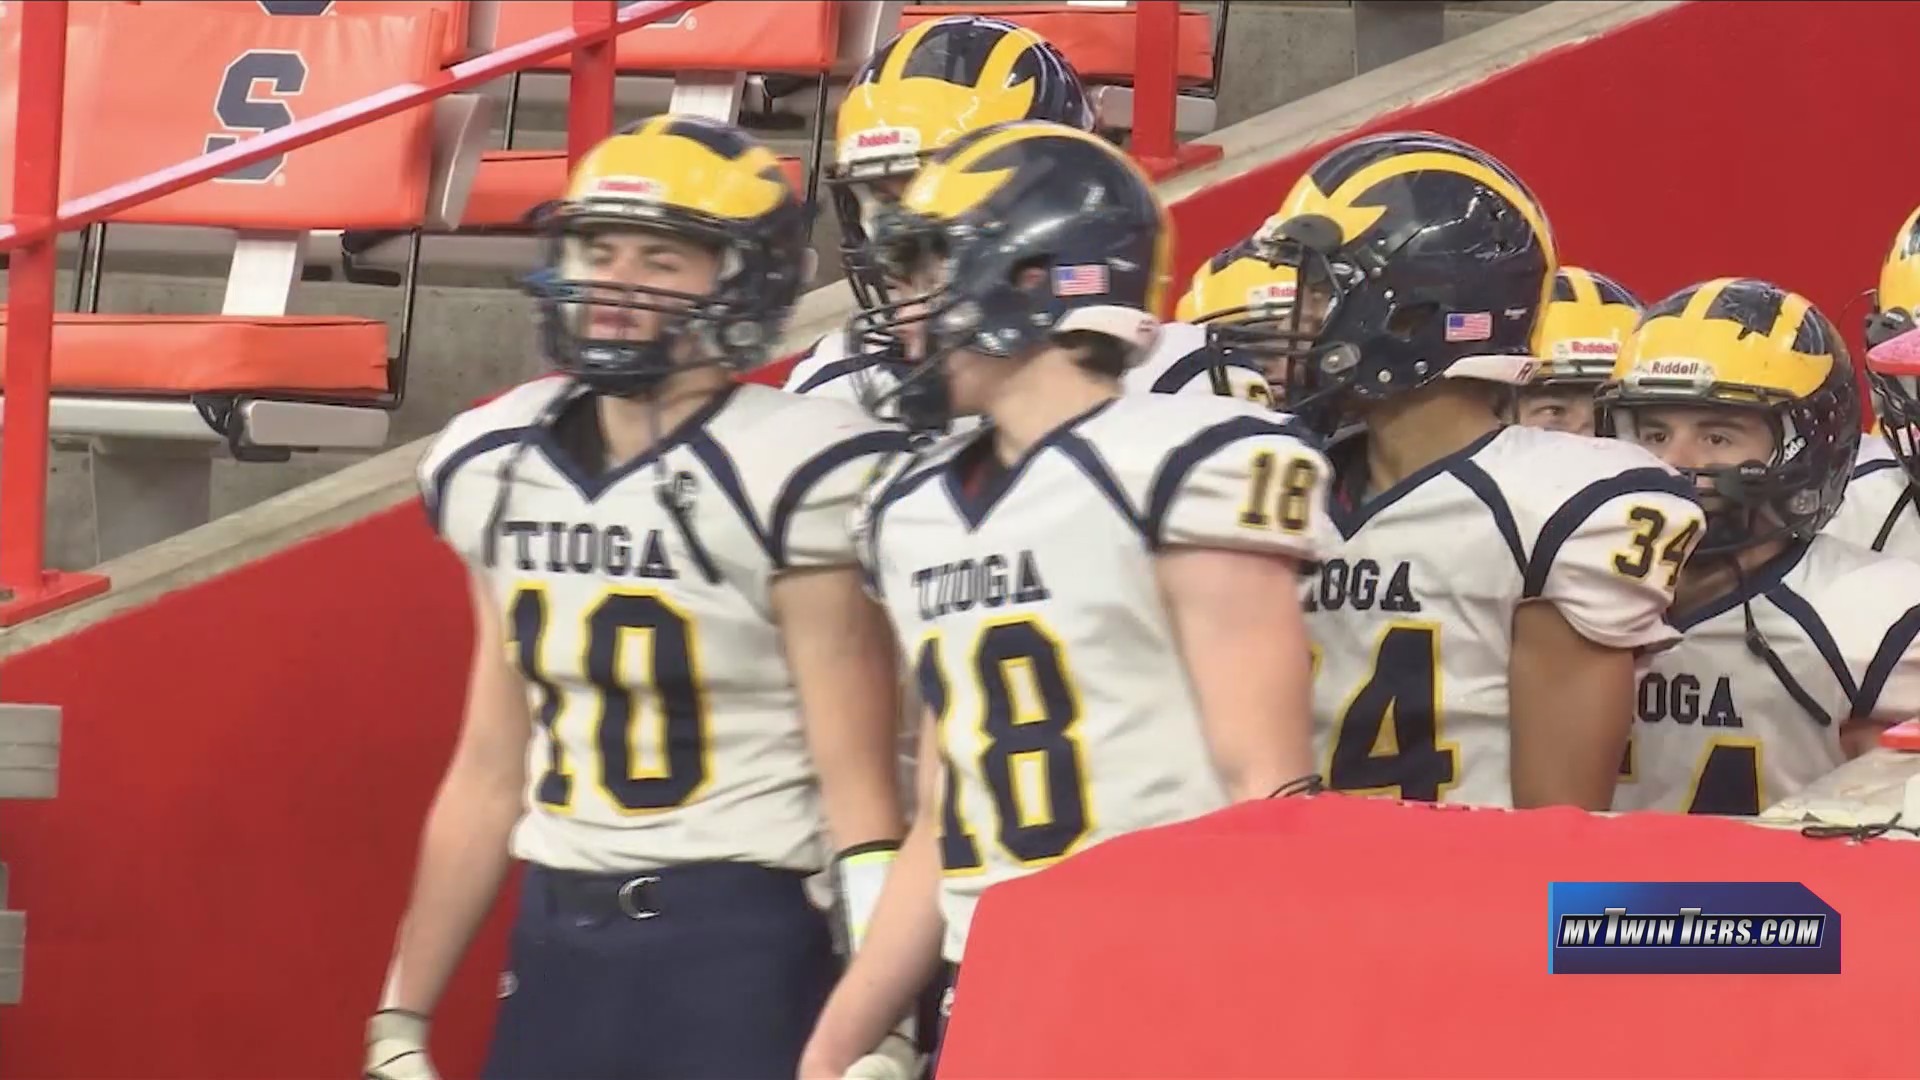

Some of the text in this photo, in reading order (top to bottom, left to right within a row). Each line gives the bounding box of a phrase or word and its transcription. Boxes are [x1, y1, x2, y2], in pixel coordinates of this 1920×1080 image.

[1652, 361, 1699, 375] Riddell
[1238, 449, 1318, 534] 18
[501, 520, 679, 580] TIOGA
[911, 549, 1053, 621] TIOGA
[1612, 503, 1700, 592] 34
[505, 580, 716, 816] 10
[1632, 672, 1743, 728] OGA
[916, 613, 1094, 876] 18
